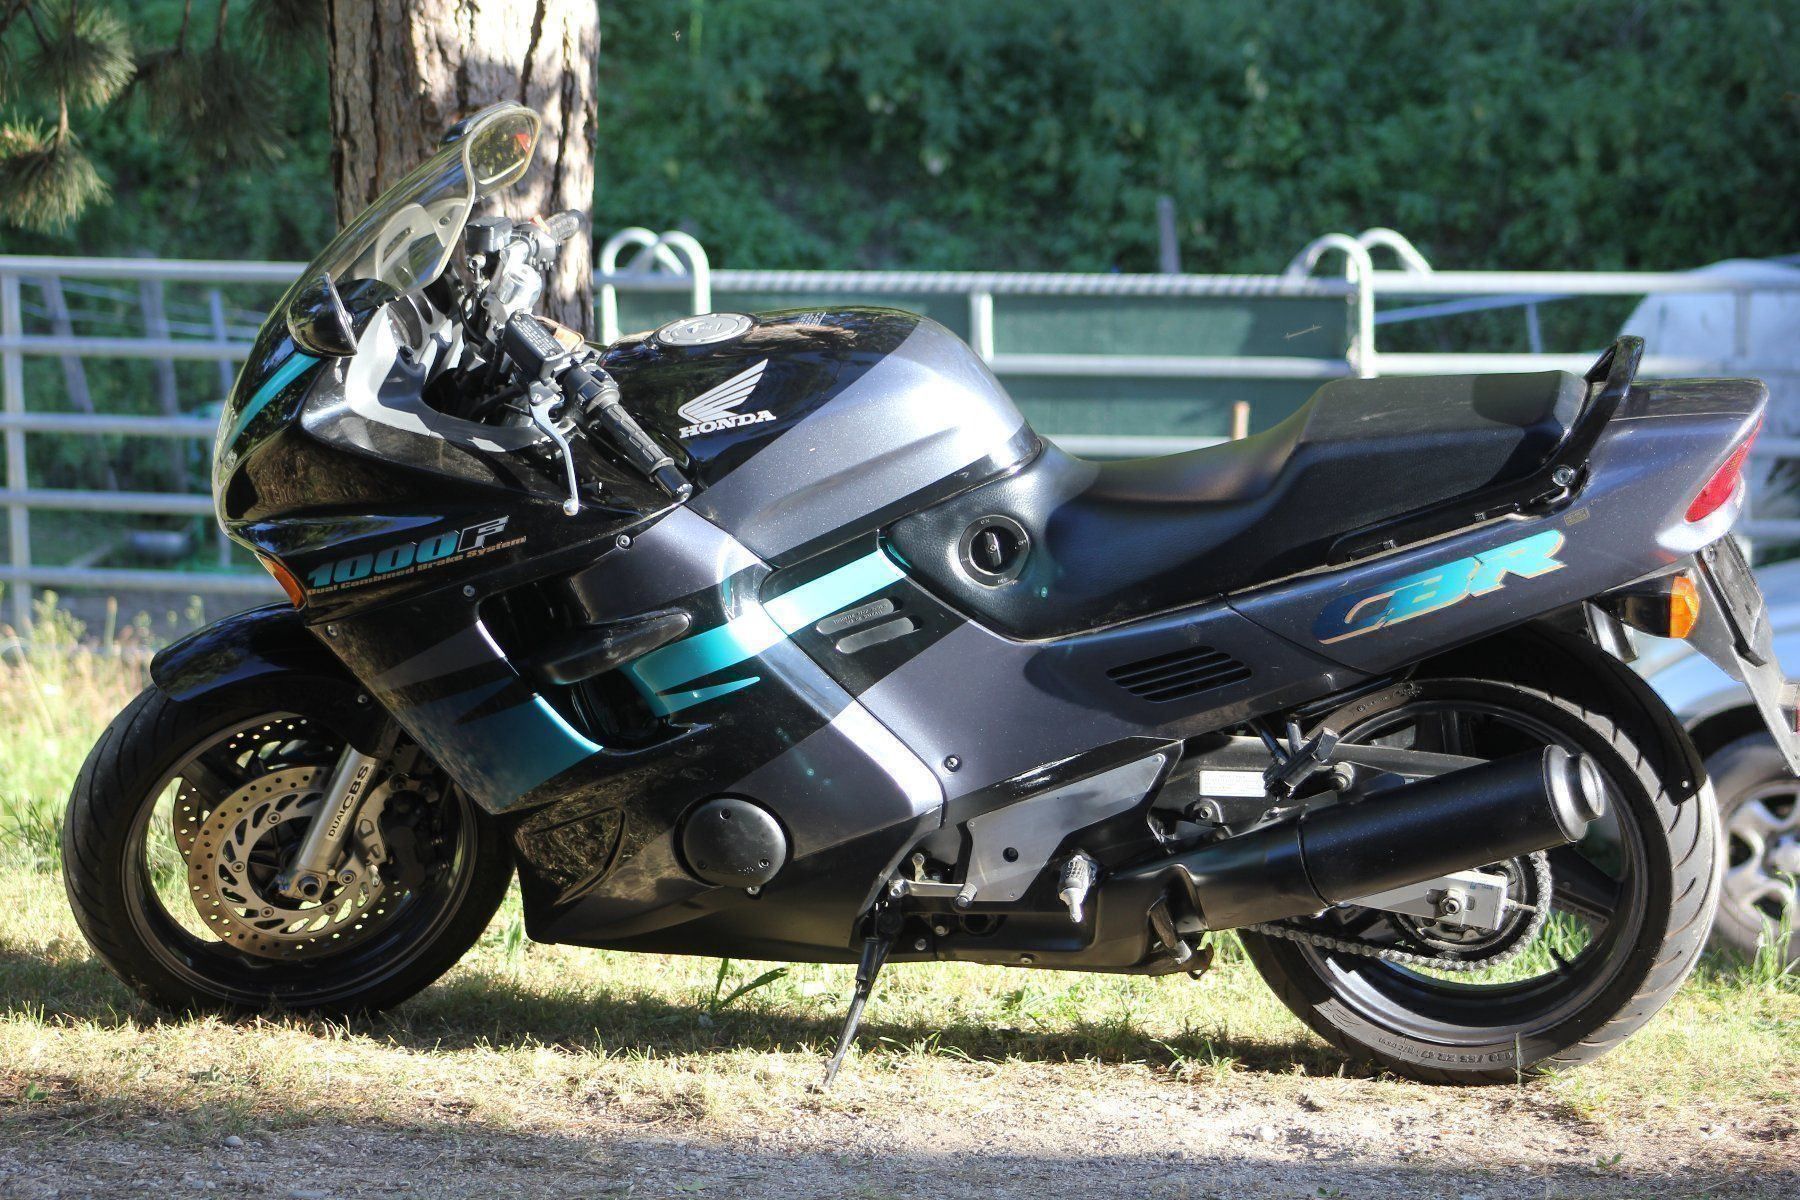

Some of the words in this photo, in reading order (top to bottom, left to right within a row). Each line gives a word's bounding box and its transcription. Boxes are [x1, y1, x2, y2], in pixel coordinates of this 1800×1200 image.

[679, 410, 776, 438] HONDA
[307, 584, 339, 596] Dual
[340, 566, 416, 589] Combined
[417, 554, 464, 572] Brake
[466, 535, 527, 558] System
[1311, 529, 1567, 645] CBR
[328, 809, 347, 837] DUAL
[342, 764, 370, 811] CBS
